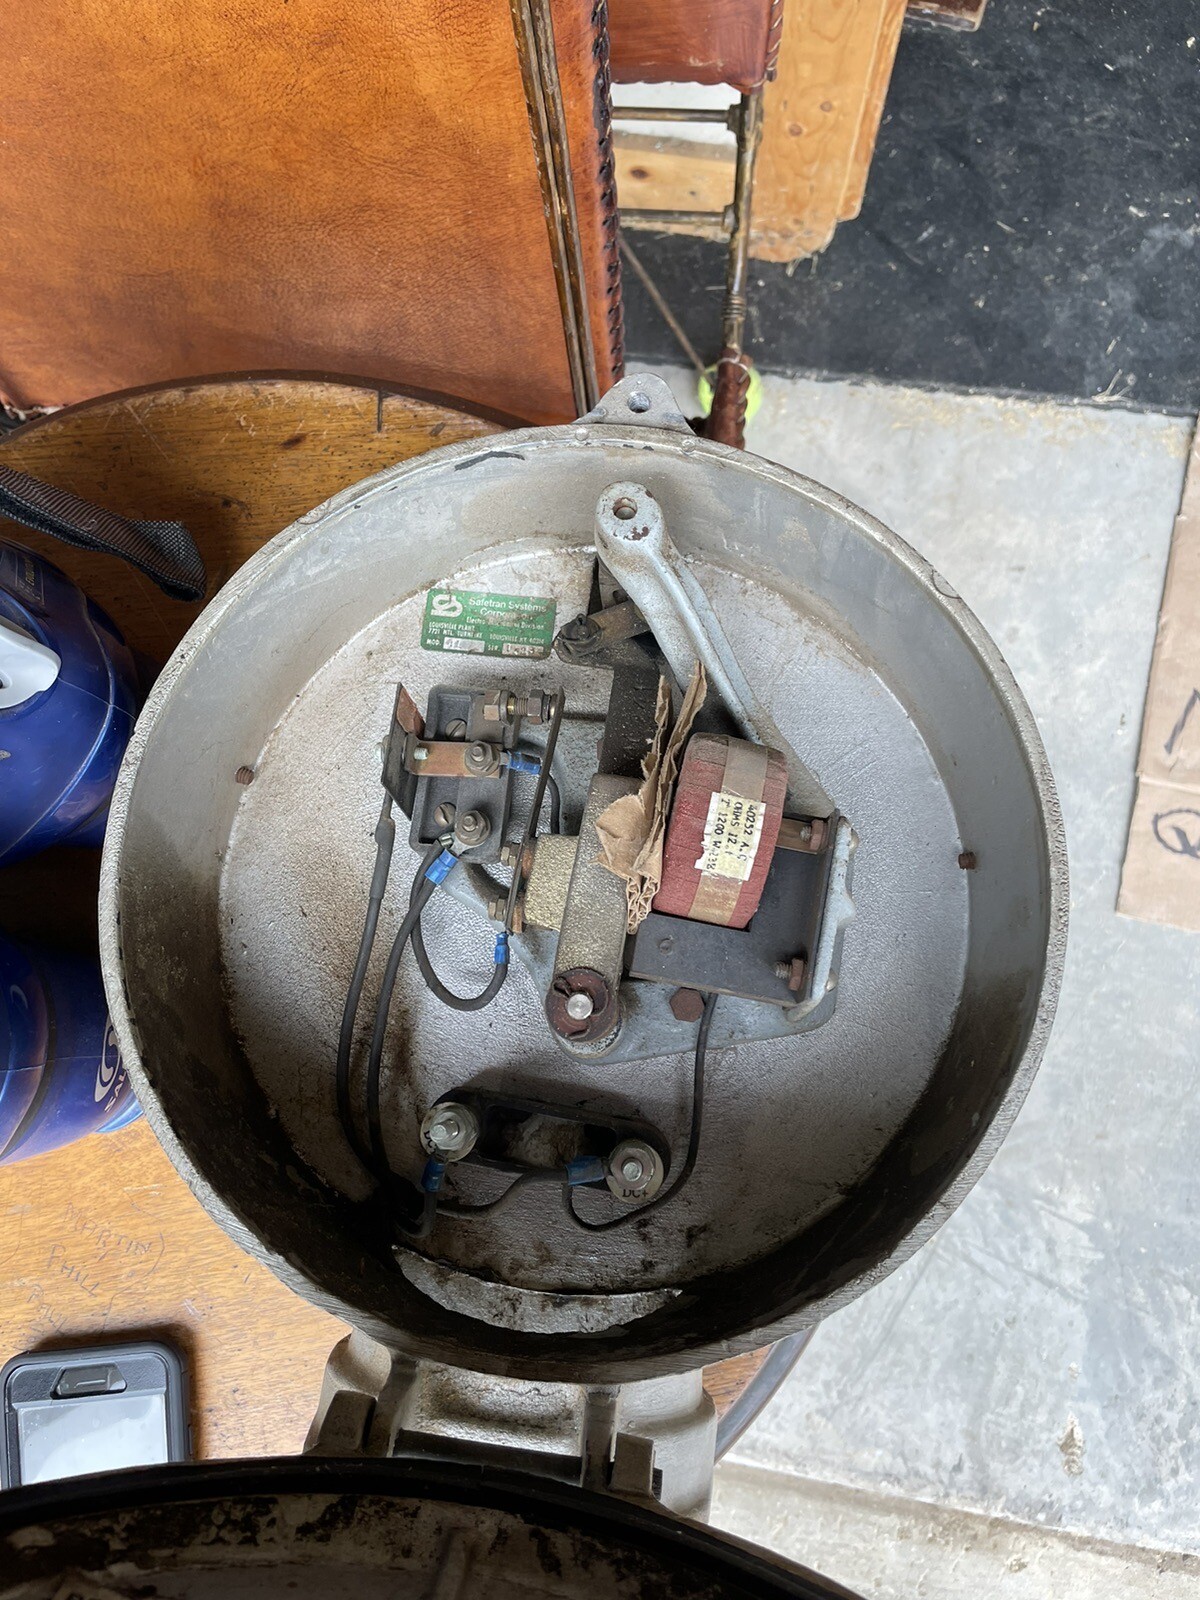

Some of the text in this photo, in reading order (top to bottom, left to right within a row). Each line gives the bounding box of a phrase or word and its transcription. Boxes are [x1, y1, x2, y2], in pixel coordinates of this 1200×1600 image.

[469, 597, 547, 613] Safetran Systems
[715, 812, 728, 836] 1200
[731, 802, 743, 827] OHMS
